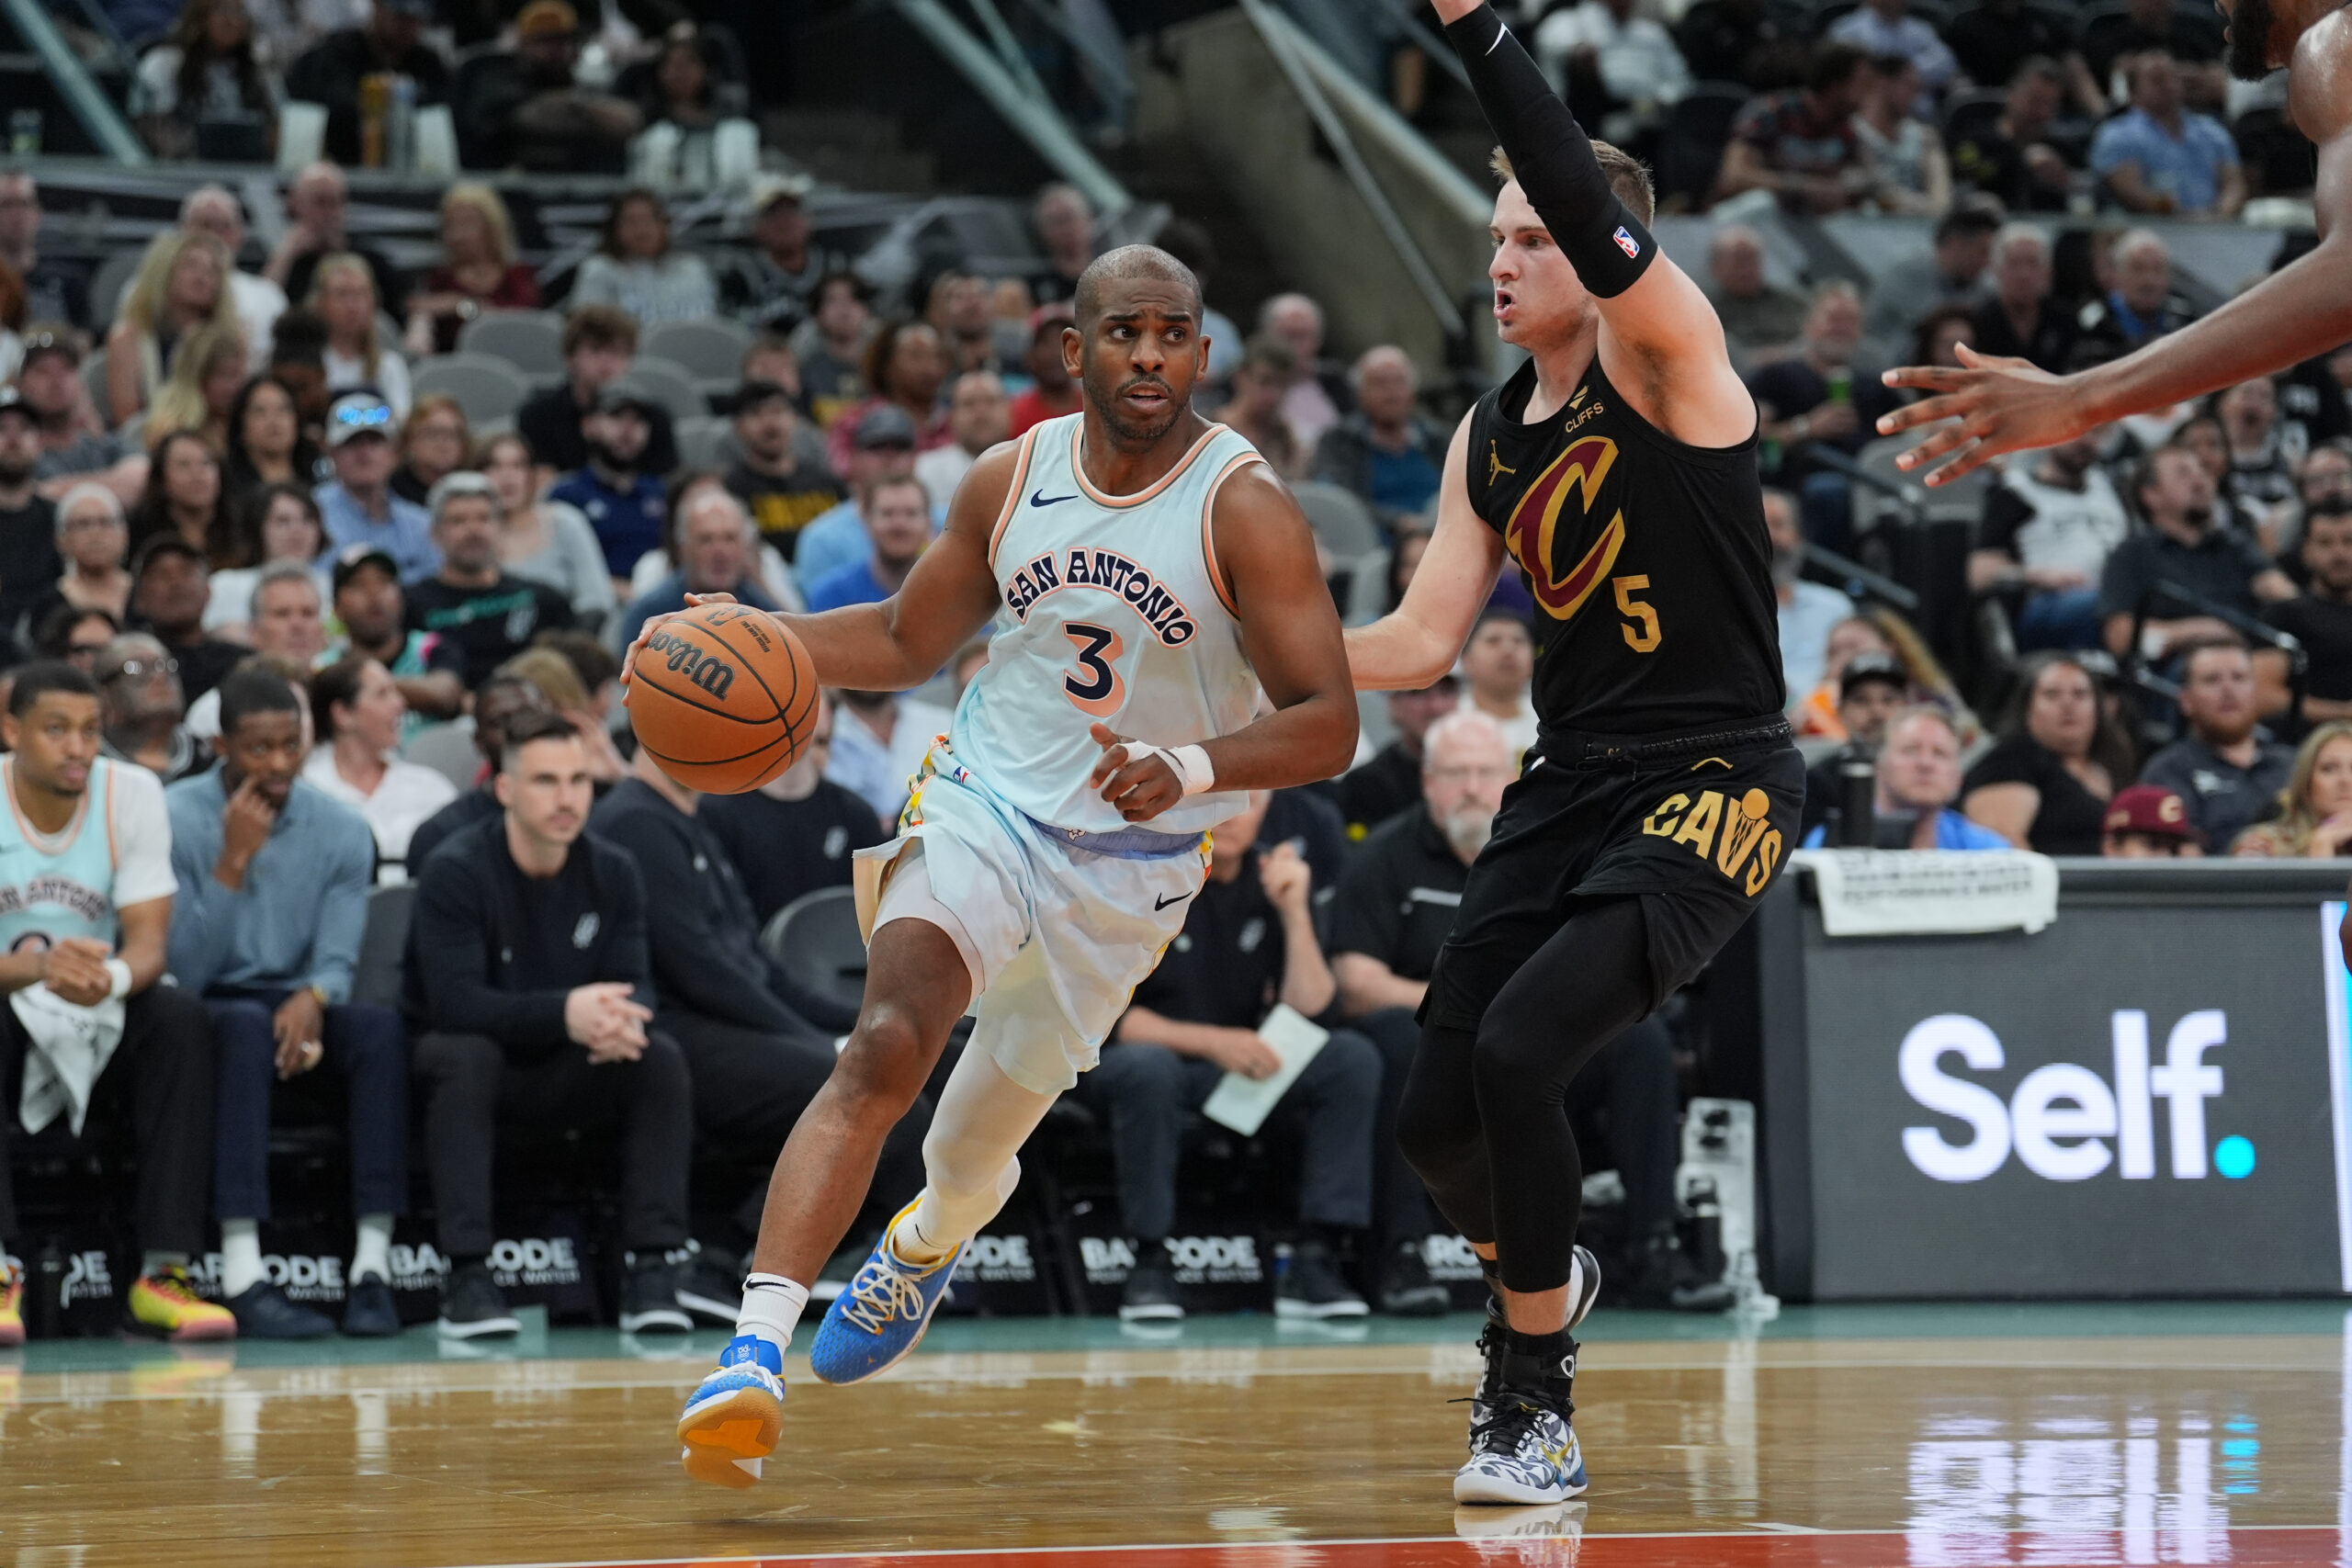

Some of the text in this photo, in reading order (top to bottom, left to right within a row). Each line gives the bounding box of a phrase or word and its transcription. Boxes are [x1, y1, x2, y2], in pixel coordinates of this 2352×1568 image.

[1565, 402, 1604, 434] CLIFFS
[1006, 549, 1195, 647] SAN ANTONIO
[1611, 574, 1662, 653] 5
[1063, 621, 1125, 716] 3
[1643, 787, 1782, 897] CAVS
